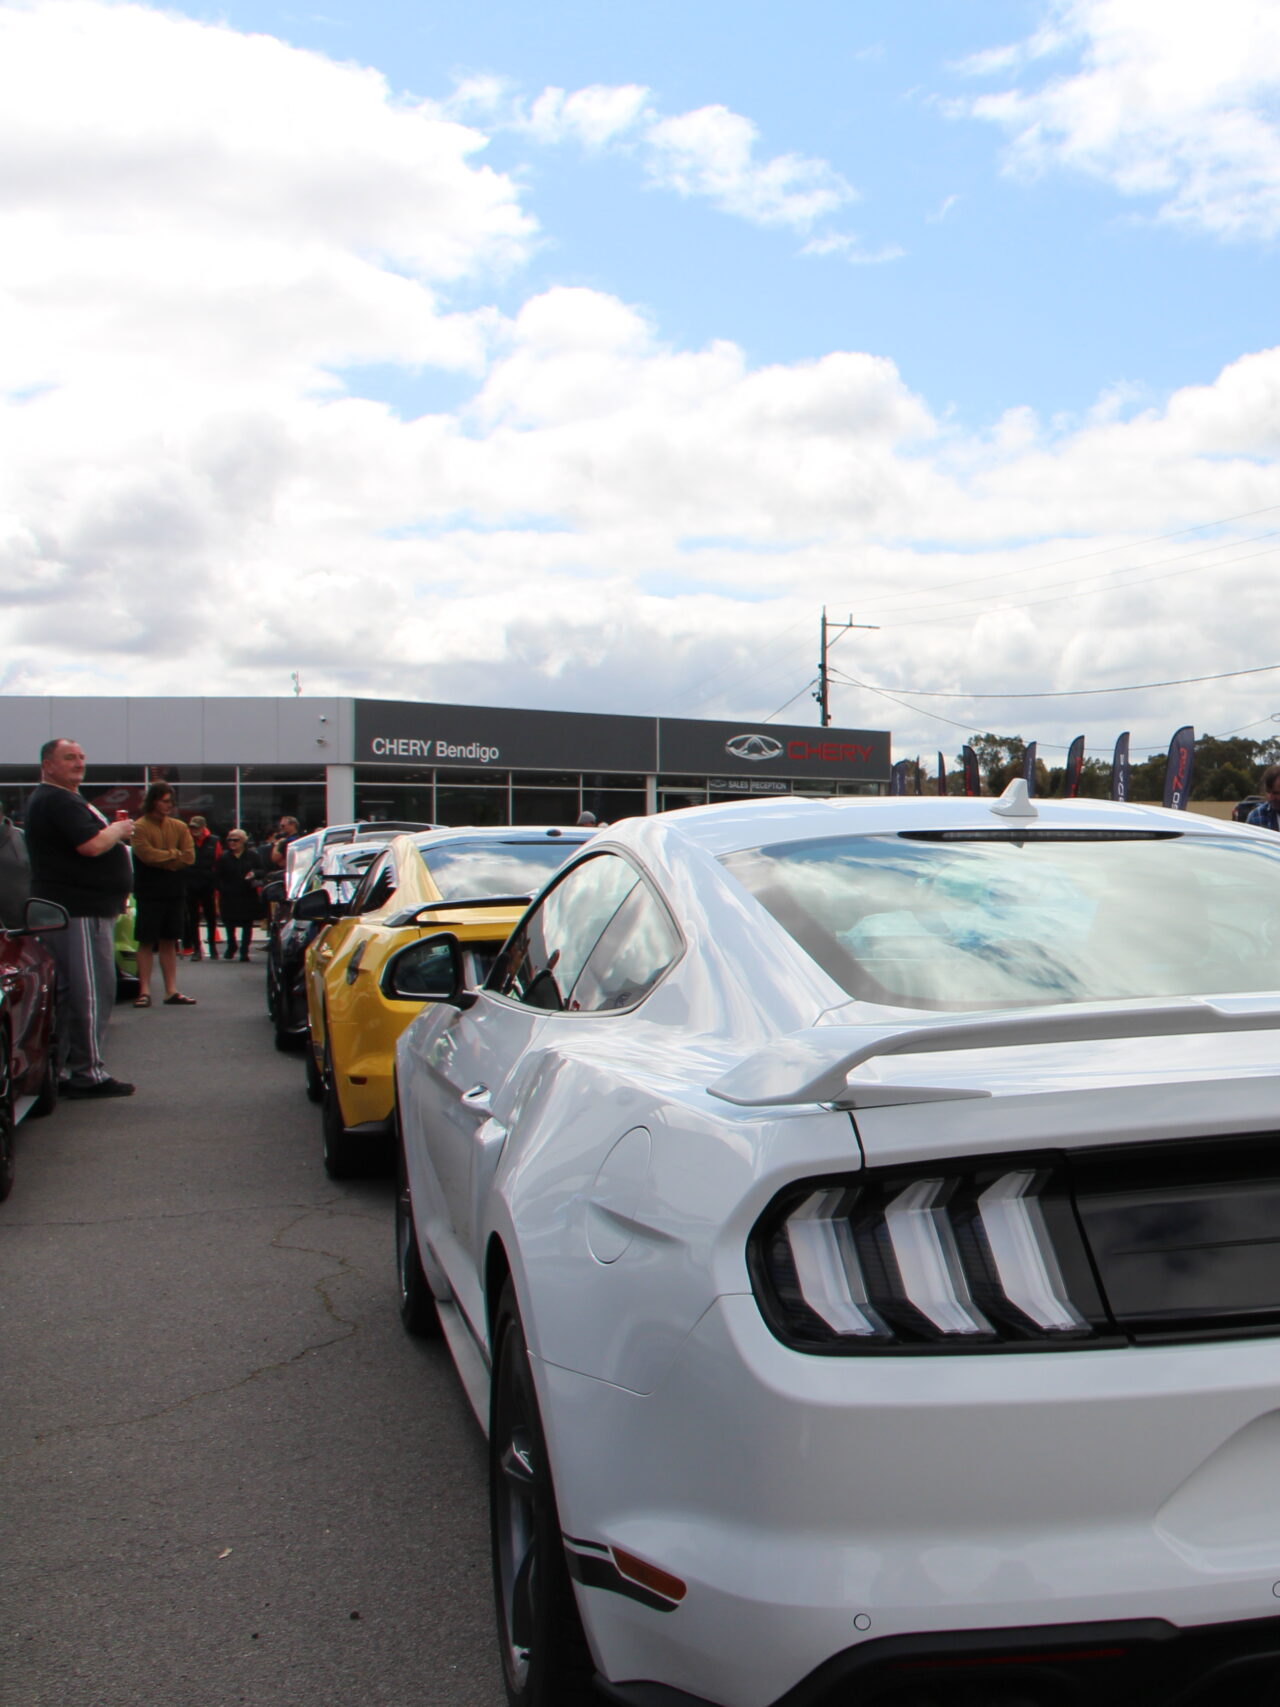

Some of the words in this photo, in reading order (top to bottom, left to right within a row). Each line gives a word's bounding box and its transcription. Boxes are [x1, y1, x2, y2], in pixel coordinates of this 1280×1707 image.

[371, 737, 431, 757] CHERY
[436, 740, 499, 763] Bendigo
[787, 741, 874, 763] CHERY
[728, 780, 748, 789] SALES
[750, 781, 787, 790] RECEPTION
